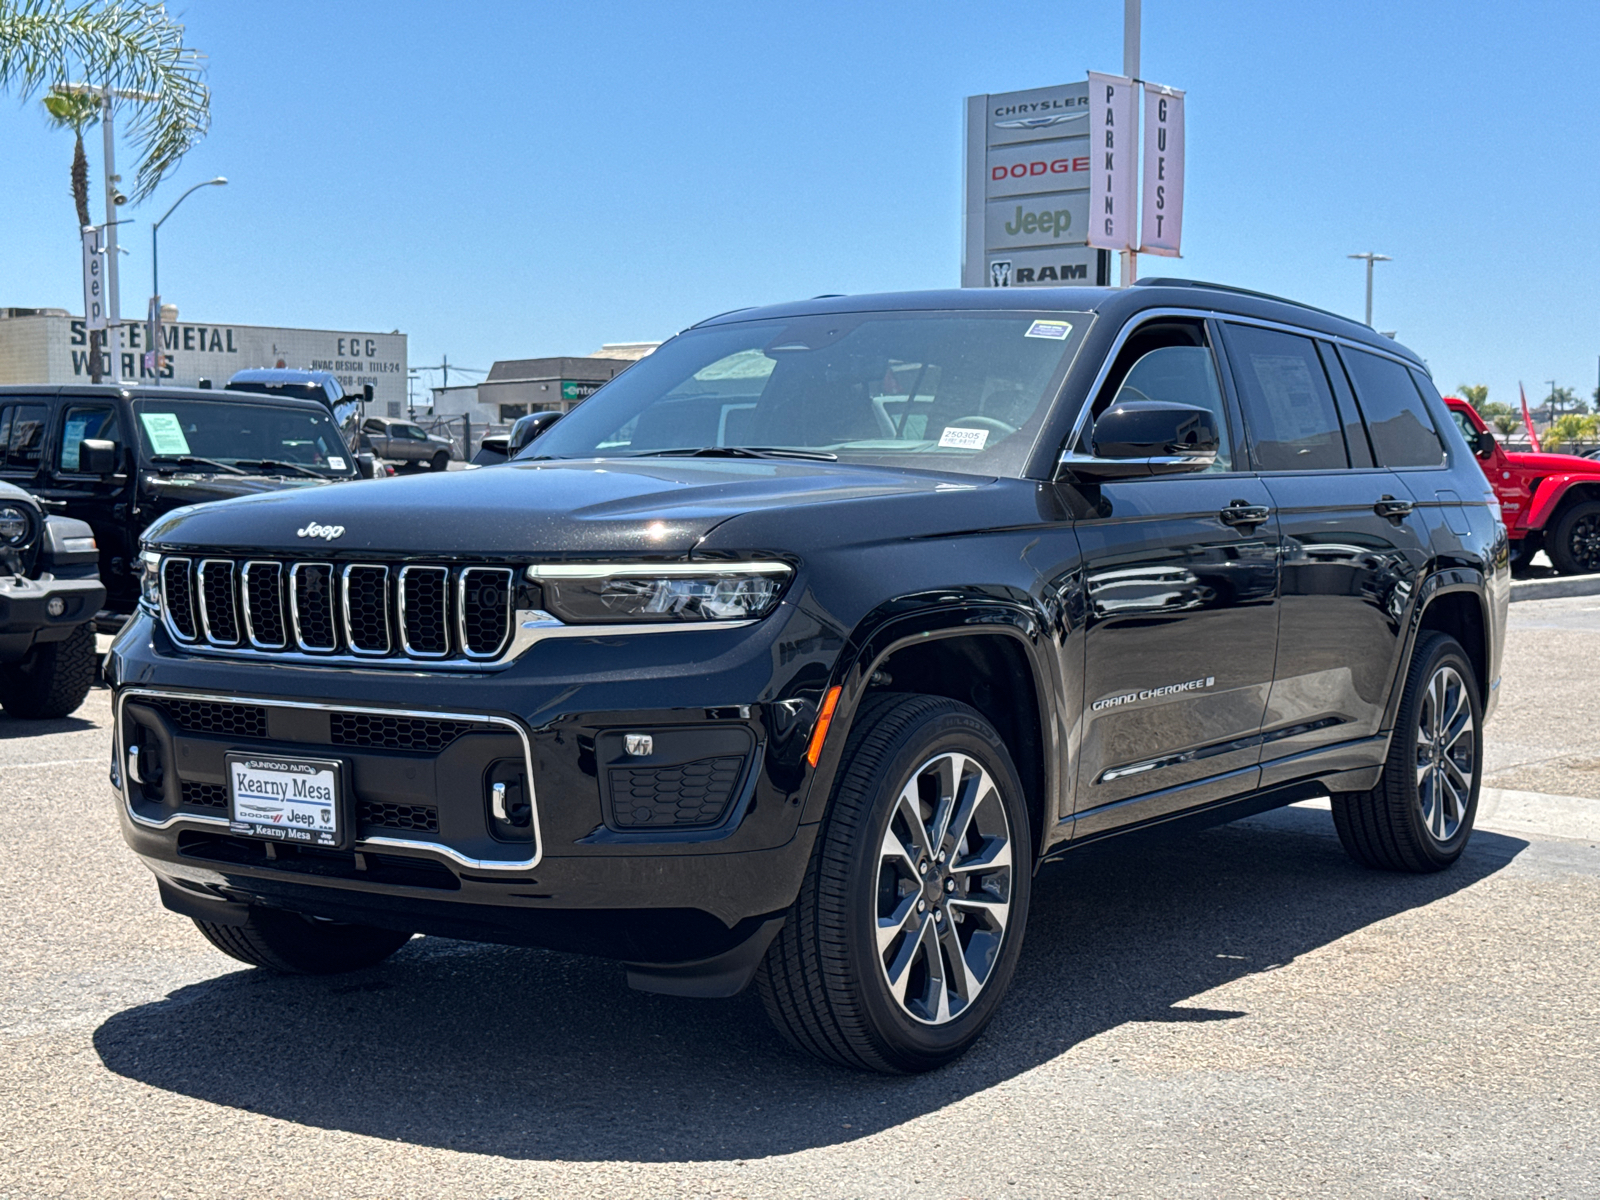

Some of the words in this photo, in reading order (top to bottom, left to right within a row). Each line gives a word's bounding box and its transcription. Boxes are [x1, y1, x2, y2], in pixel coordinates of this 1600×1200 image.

[995, 97, 1089, 117] CHRYSLER
[992, 156, 1090, 181] DODGE
[1105, 85, 1114, 237] PARKING
[1156, 98, 1167, 238] GUEST
[1005, 206, 1072, 238] Jeep
[90, 233, 100, 322] Jeep
[1016, 264, 1088, 284] RAM
[297, 521, 345, 541] Jeep
[1091, 692, 1137, 711] GRAND
[1139, 678, 1204, 700] CHEROKEE
[251, 760, 288, 771] SUNROAD
[290, 764, 311, 772] AUTO
[237, 773, 288, 802] Kearny
[292, 778, 331, 801] Mesa
[287, 809, 315, 827] Jeep
[256, 824, 286, 840] Kearny
[288, 828, 311, 840] Mesa
